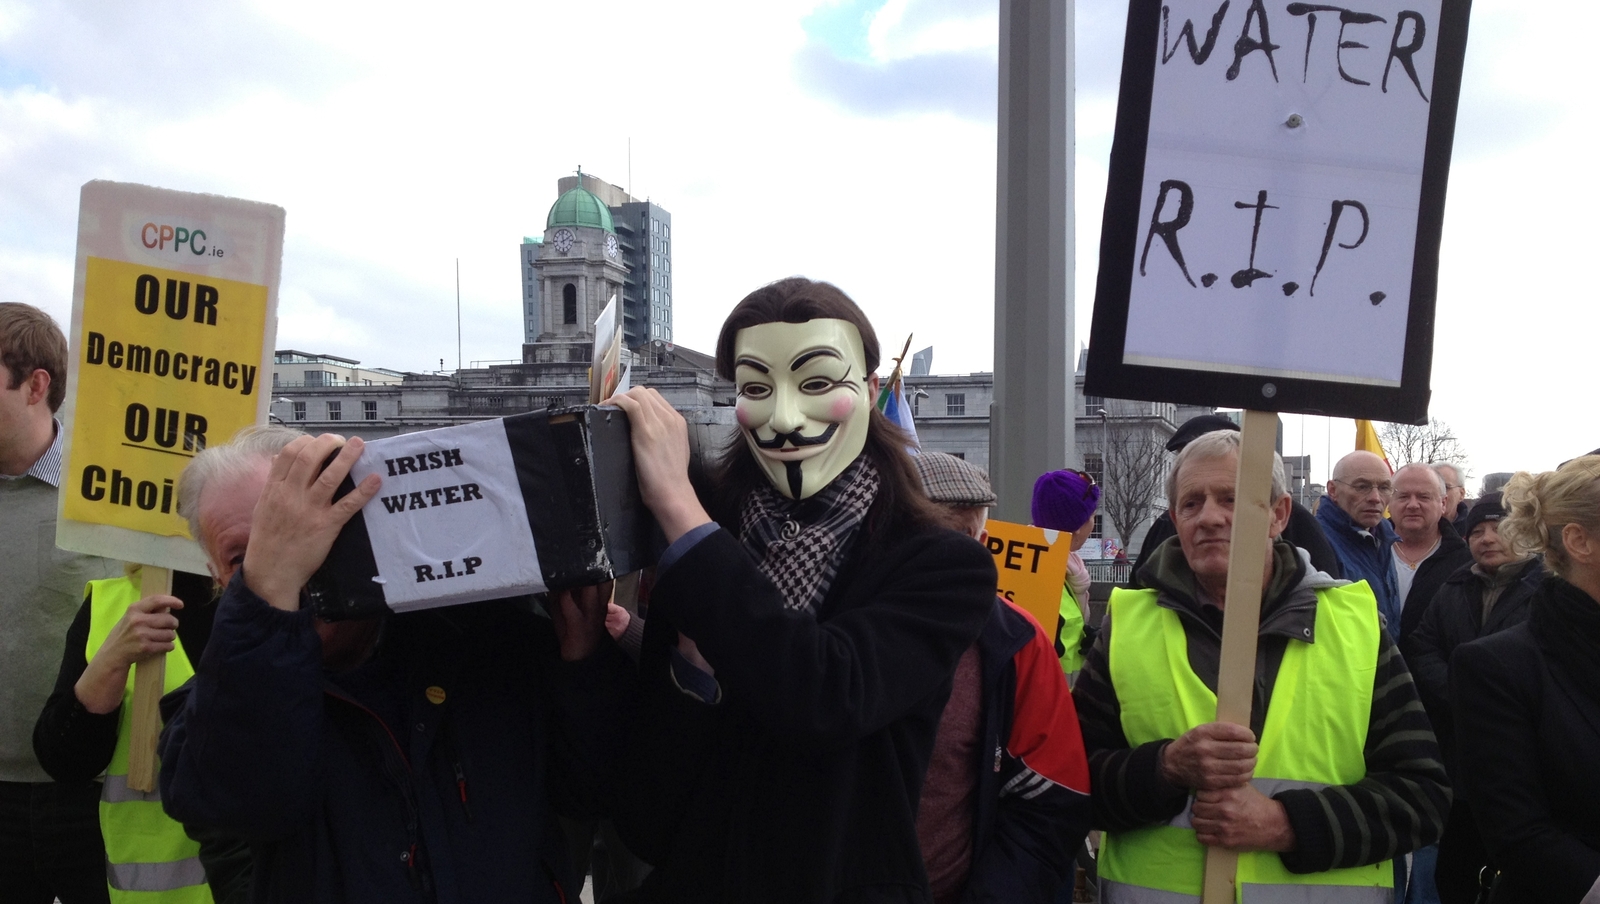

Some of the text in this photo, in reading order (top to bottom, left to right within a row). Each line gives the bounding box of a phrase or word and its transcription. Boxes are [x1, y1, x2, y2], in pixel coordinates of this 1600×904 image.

[1162, 0, 1429, 103] WATER
[141, 222, 224, 258] CPPC.ie
[1139, 179, 1387, 306] R.I.P.
[134, 274, 219, 326] OUR
[87, 331, 257, 395] Democracy
[124, 403, 208, 453] OUR
[385, 449, 463, 477] IRISH
[81, 464, 174, 514] Choi
[381, 483, 483, 514] WATER
[414, 556, 482, 583] R.I.P
